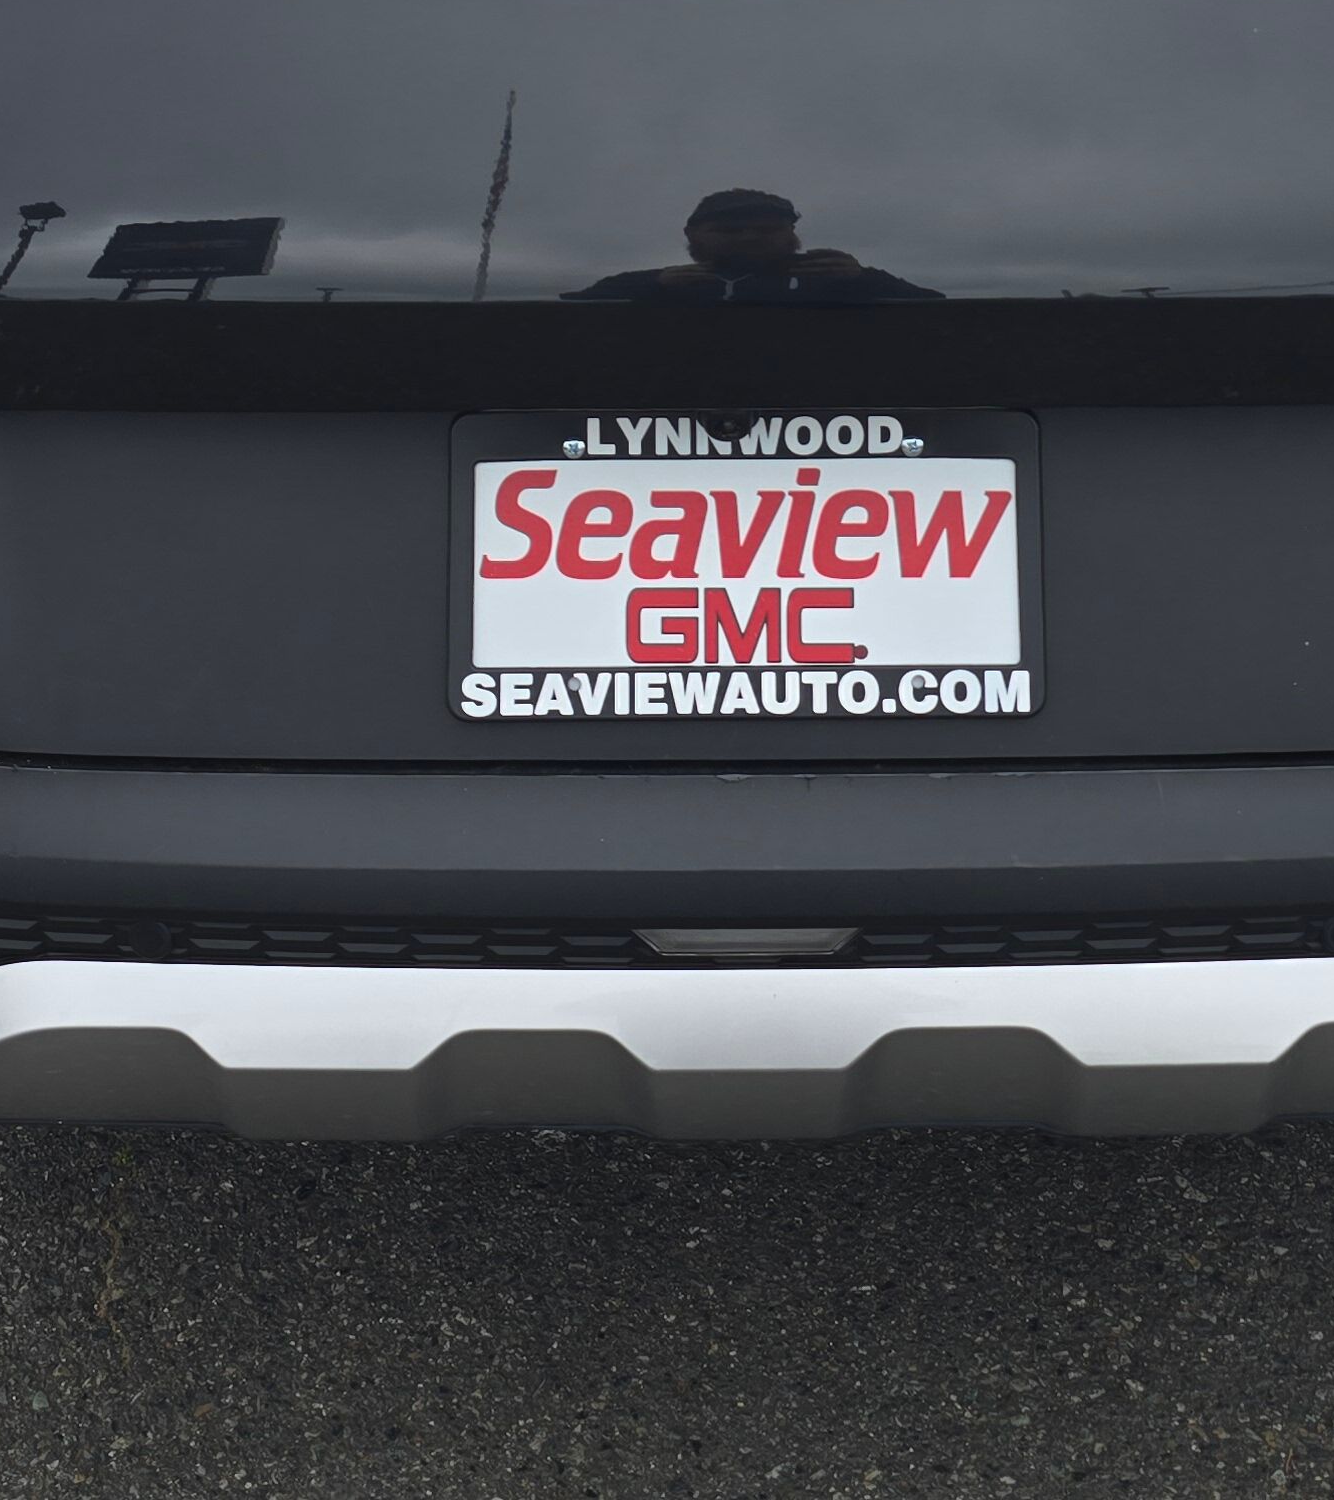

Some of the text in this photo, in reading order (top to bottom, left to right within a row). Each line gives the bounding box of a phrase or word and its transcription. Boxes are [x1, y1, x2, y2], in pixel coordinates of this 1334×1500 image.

[479, 467, 1013, 581] Seaview
[625, 587, 857, 666] GMC
[460, 669, 1032, 719] SEAVIEWAUTO.COM
